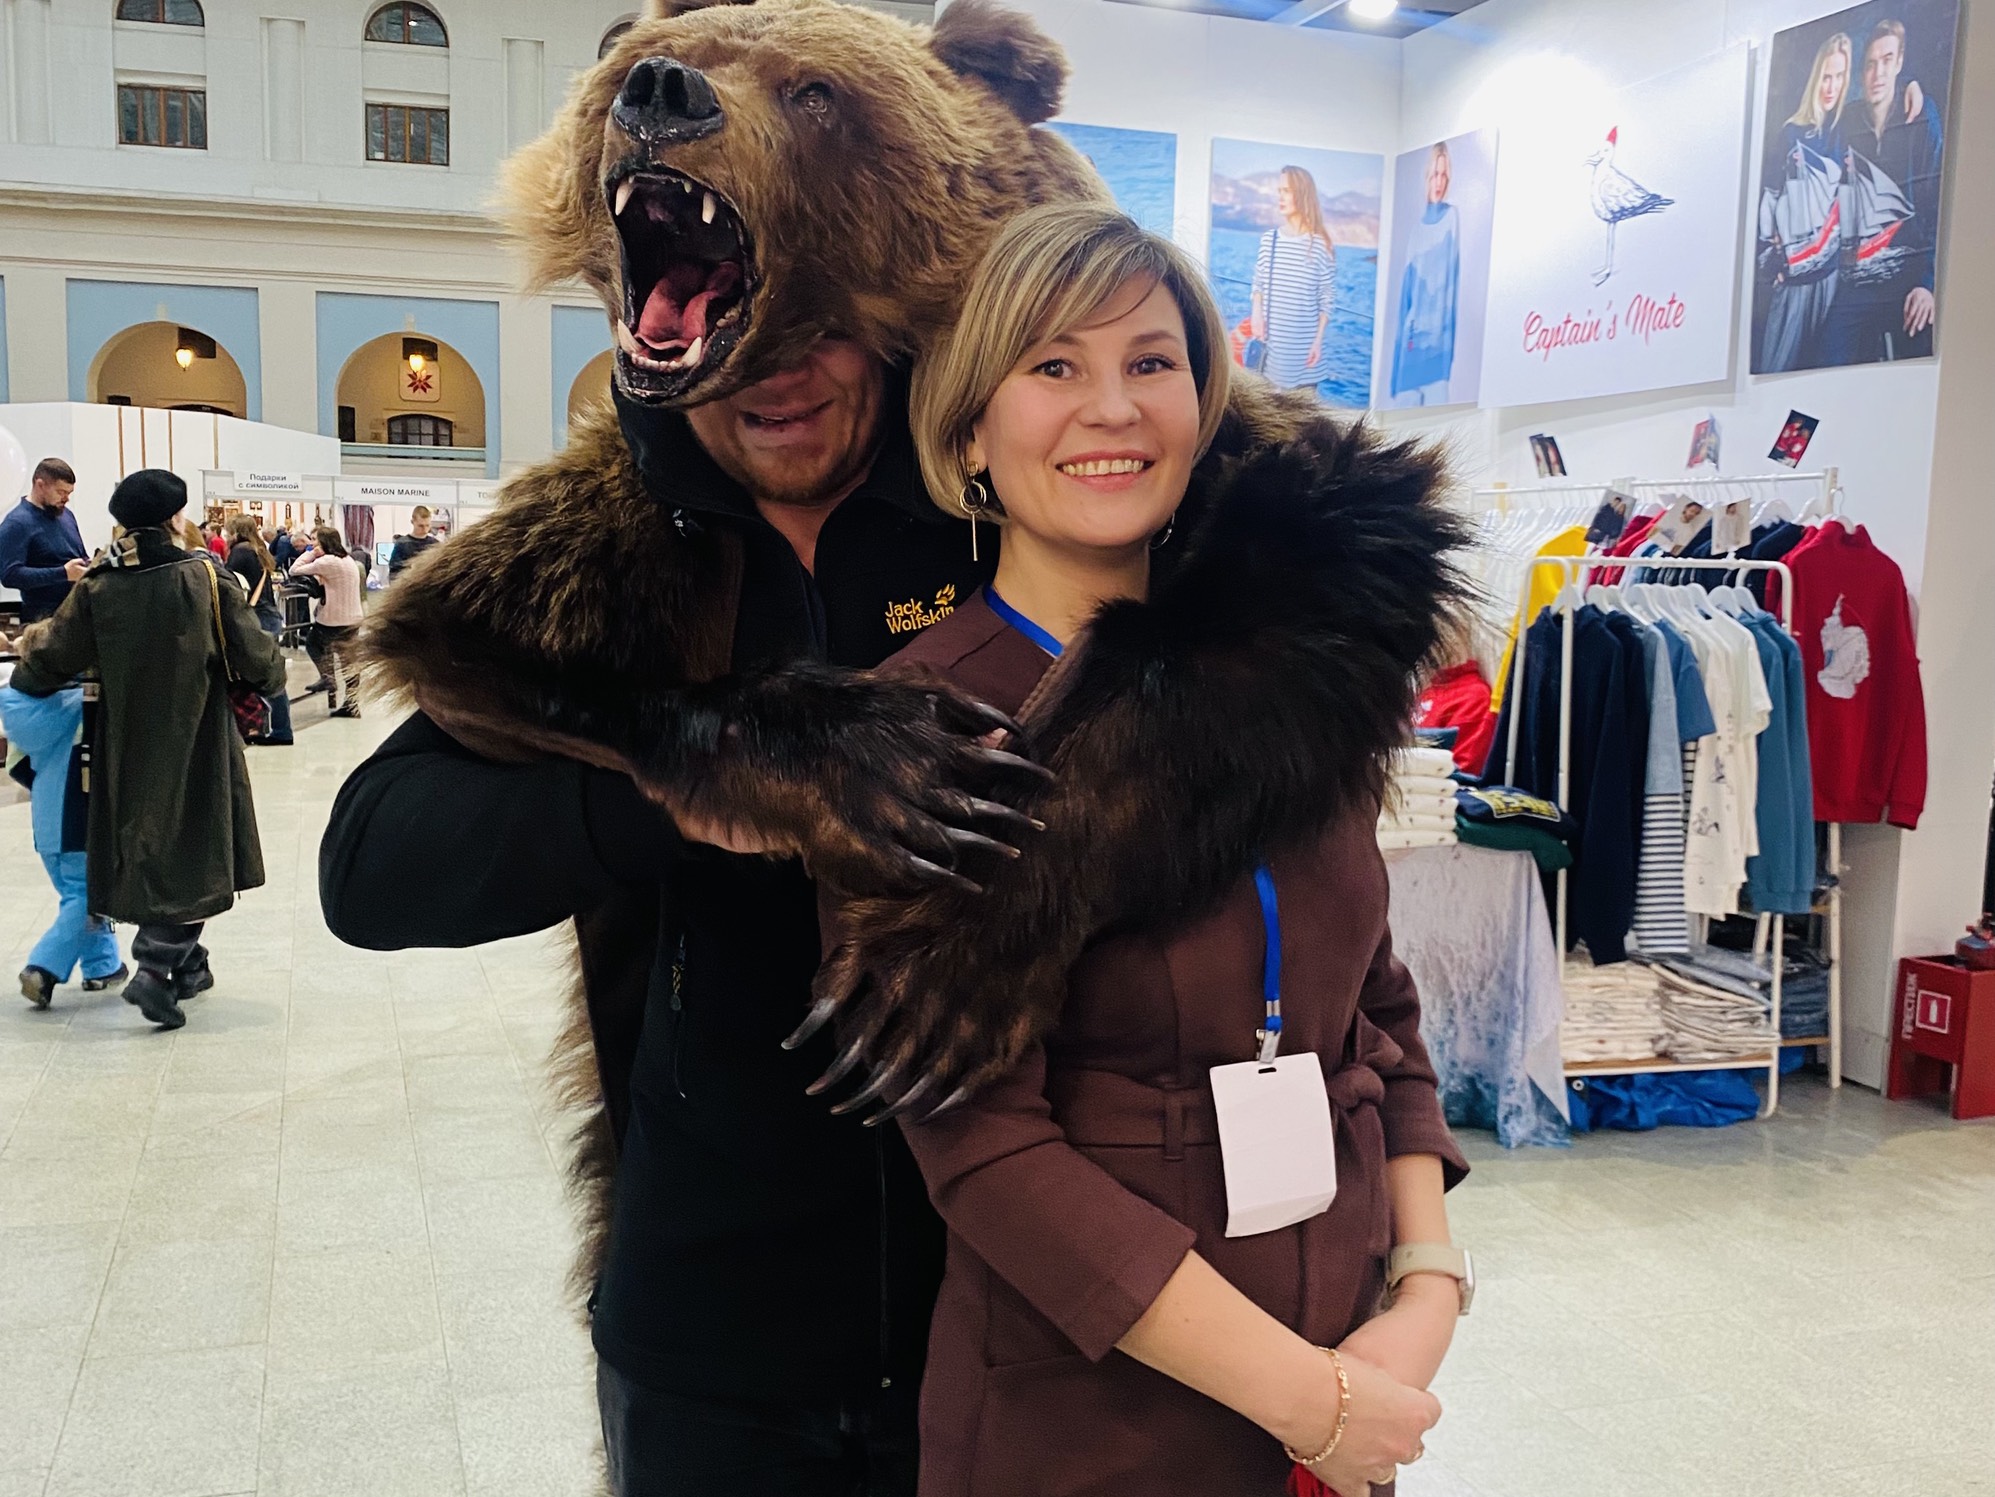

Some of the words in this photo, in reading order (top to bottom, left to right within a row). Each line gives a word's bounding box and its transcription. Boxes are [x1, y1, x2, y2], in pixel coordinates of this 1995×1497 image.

[1523, 301, 1617, 362] Captain's
[1625, 292, 1685, 346] Mate
[249, 473, 286, 481] Подарки
[361, 487, 395, 495] MAISON
[397, 489, 430, 497] MARINE
[885, 598, 923, 617] Jack
[886, 606, 954, 634] Wolfskin
